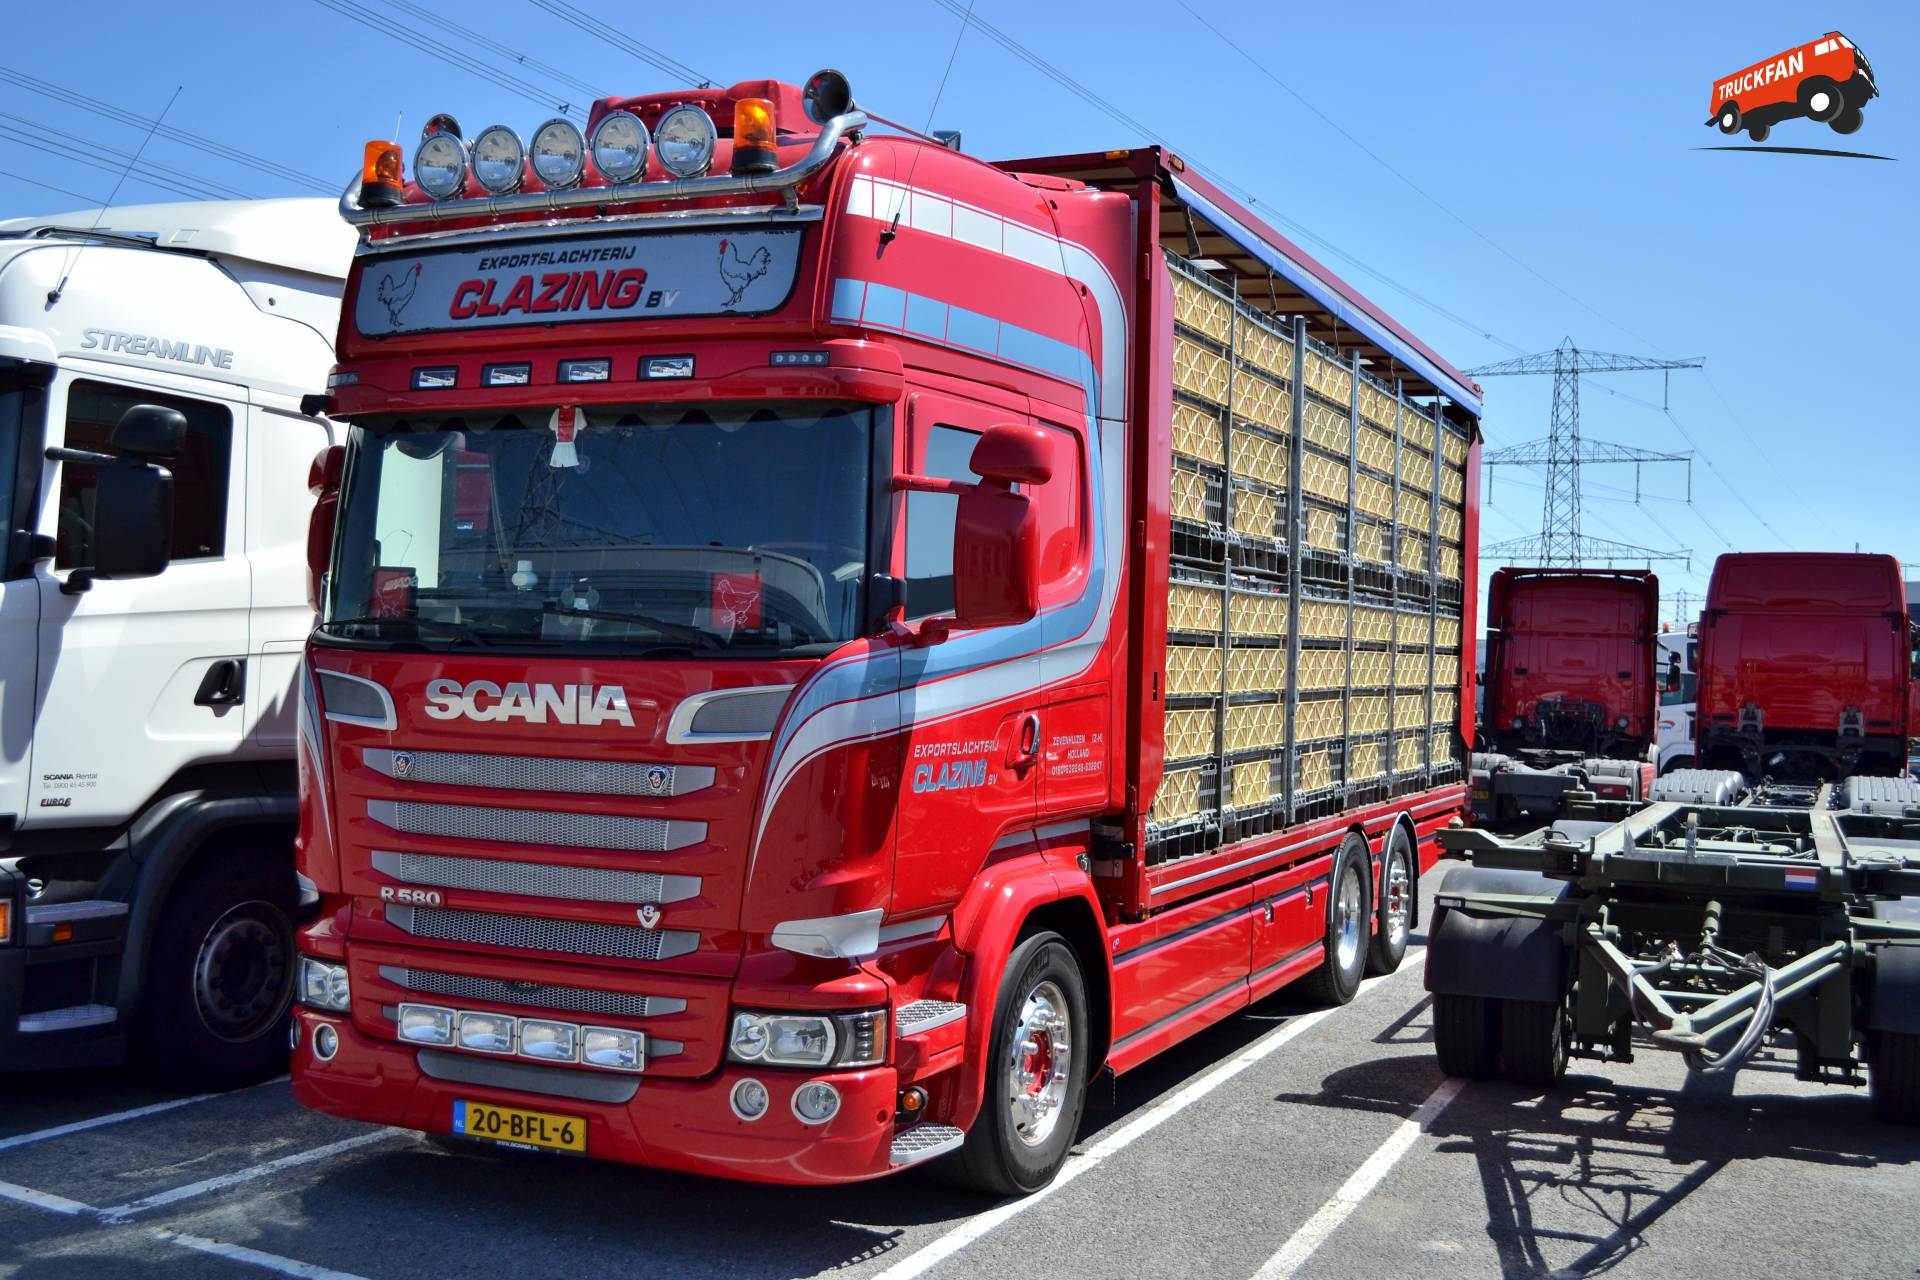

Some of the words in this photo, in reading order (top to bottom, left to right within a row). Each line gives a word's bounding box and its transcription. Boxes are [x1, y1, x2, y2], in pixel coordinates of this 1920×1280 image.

[478, 245, 636, 271] EXPORTSLACHTERIJ
[450, 268, 647, 319] CLAZING
[646, 290, 678, 309] BV
[80, 327, 234, 370] STREAMLINE
[424, 678, 636, 728] SCANIA
[913, 739, 1000, 758] EXPORTSLACHTERIJ
[1067, 748, 1089, 759] HOLLAND
[912, 758, 988, 794] CLAZING
[987, 773, 998, 785] BV
[381, 886, 395, 901] R
[398, 888, 440, 906] 580
[455, 1119, 465, 1128] NL
[472, 1108, 575, 1145] 20-BFL-6
